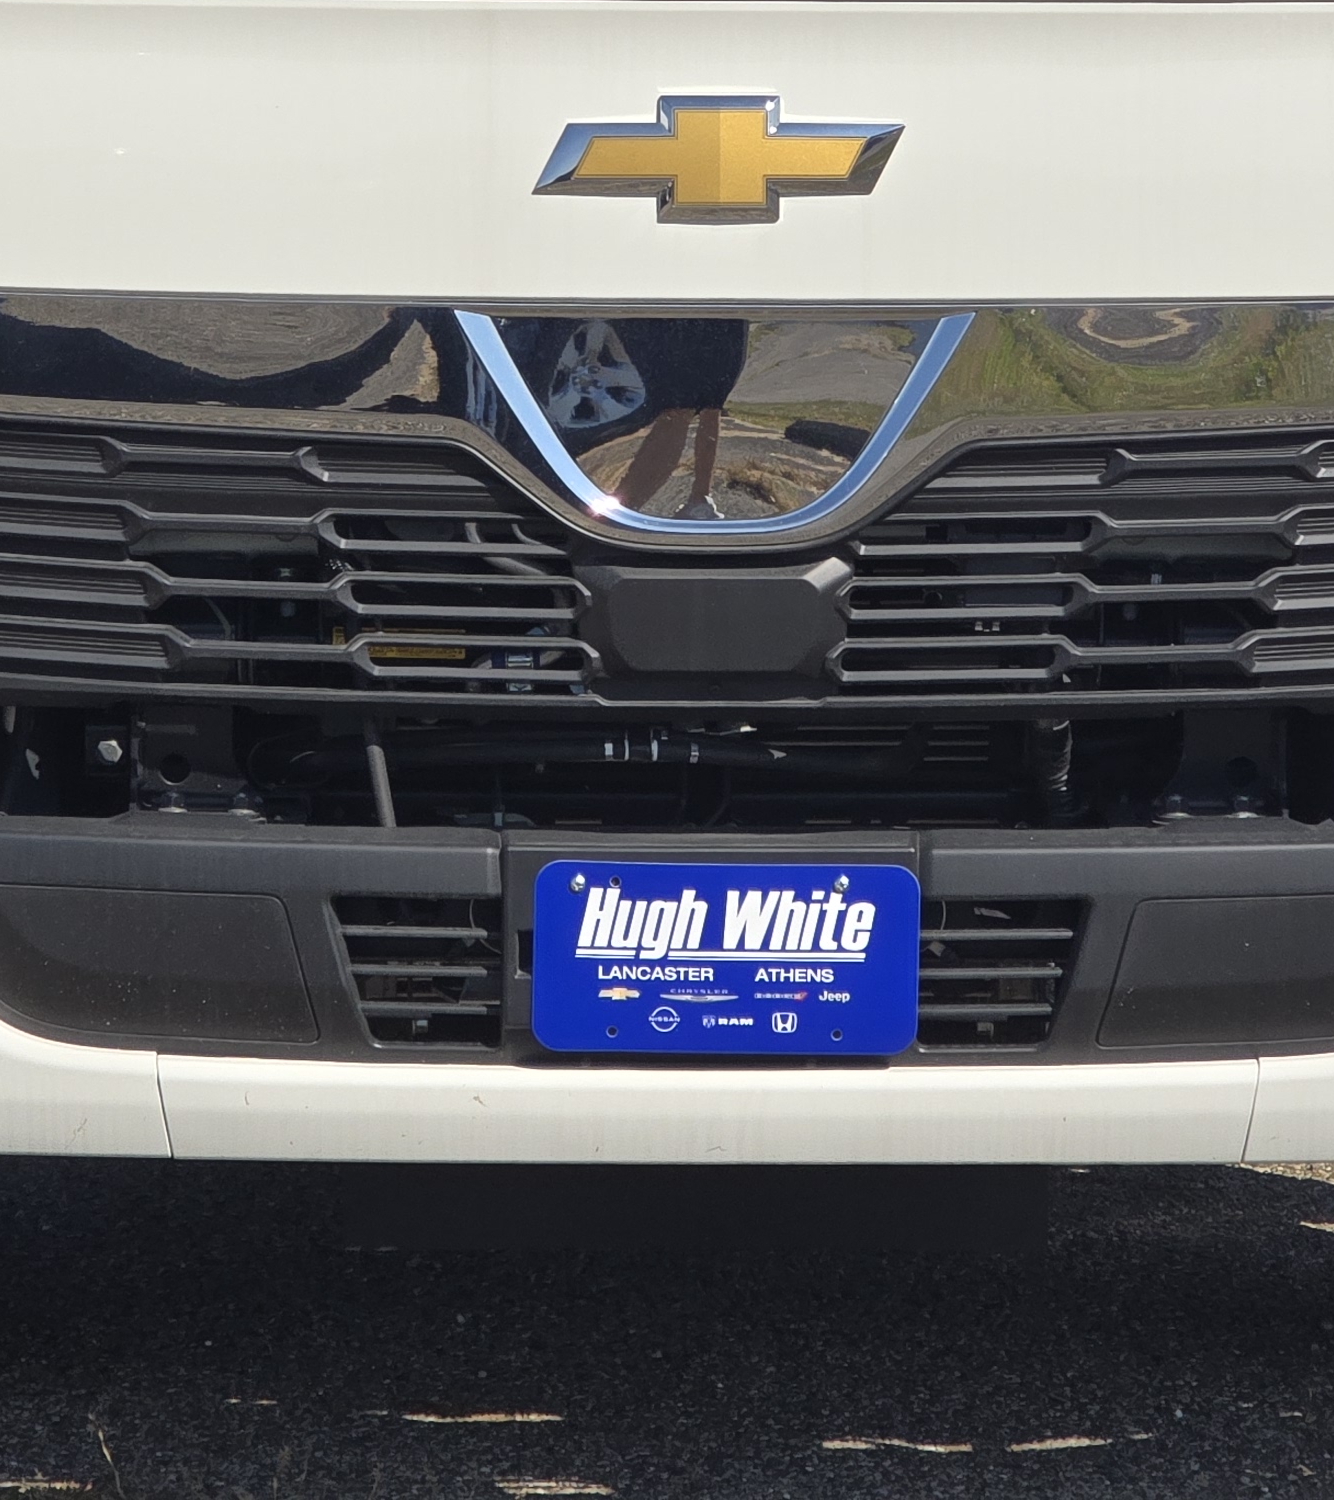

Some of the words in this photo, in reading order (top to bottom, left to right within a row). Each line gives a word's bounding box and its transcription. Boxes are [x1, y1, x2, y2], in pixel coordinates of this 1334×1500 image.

[576, 886, 709, 961] Hugh
[722, 888, 877, 952] White
[597, 965, 714, 982] LANCASTER
[754, 967, 835, 983] ATHENS
[818, 990, 851, 1003] Jeep
[718, 1017, 754, 1026] RAM
